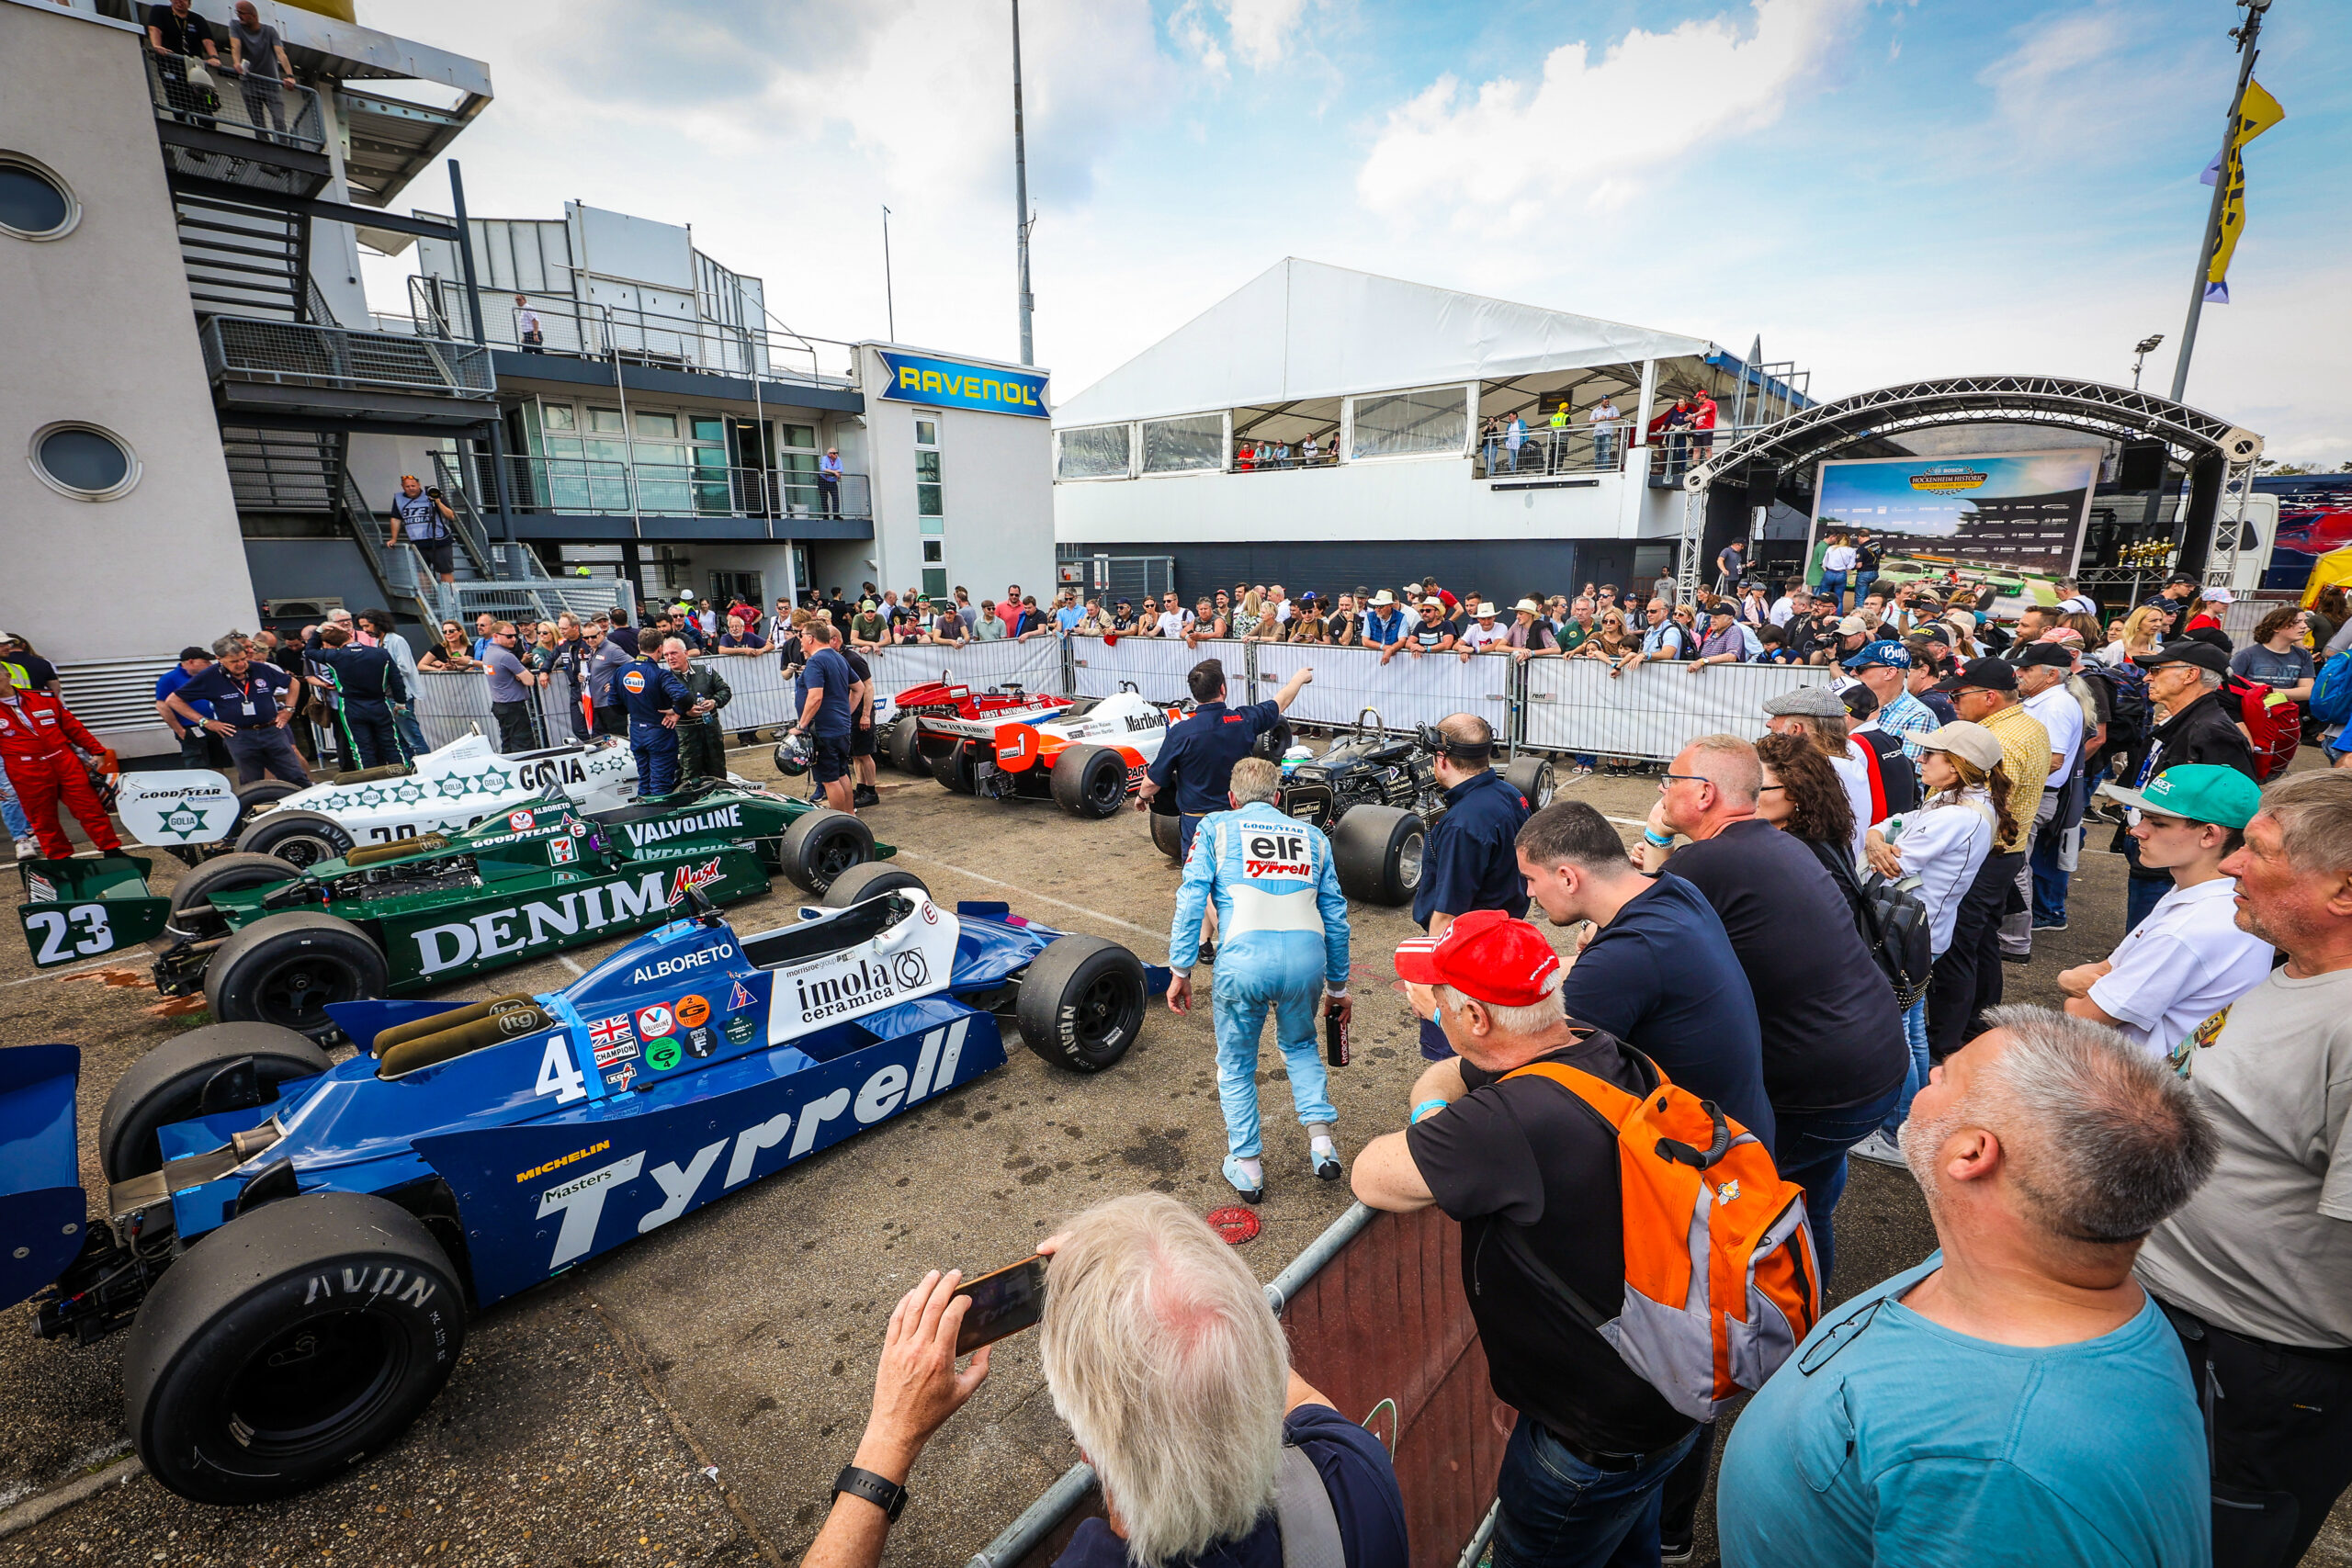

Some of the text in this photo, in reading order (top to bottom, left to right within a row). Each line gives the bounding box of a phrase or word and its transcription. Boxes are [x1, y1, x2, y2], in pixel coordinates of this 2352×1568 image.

[899, 367, 1037, 406] RAVENOL
[625, 677, 644, 686] Gulf
[979, 703, 1043, 719] FIRST NATIONAL CITY
[1125, 713, 1170, 733] Marlboro
[1017, 733, 1025, 756] 1
[400, 788, 418, 796] GOLIA
[444, 783, 463, 792] GOLIA
[484, 777, 503, 787] GOLIA
[363, 794, 379, 802] GOLIA
[533, 802, 571, 816] ALBORETO
[170, 817, 196, 826] GOLIA
[573, 824, 583, 837] E
[624, 804, 743, 848] VALVOLINE
[1243, 823, 1304, 834] GOODYEAR
[1250, 836, 1304, 861] elf
[1246, 860, 1311, 878] Tyrrell
[411, 871, 671, 976] DENIM
[26, 904, 114, 964] 23
[633, 944, 733, 985] ALBORETO
[797, 959, 892, 1011] imola
[801, 987, 895, 1023] ceramica
[503, 1012, 532, 1030] itg
[643, 1019, 670, 1033] VALVOLINE
[595, 1043, 635, 1063] CHAMPION
[535, 1034, 587, 1105] 4
[663, 1060, 672, 1068] 4
[610, 1069, 635, 1083] KONI
[536, 1017, 971, 1269] Tyrrell
[515, 1139, 611, 1183] MICHELIN
[545, 1169, 612, 1204] Masters
[304, 1267, 436, 1309] AVON
